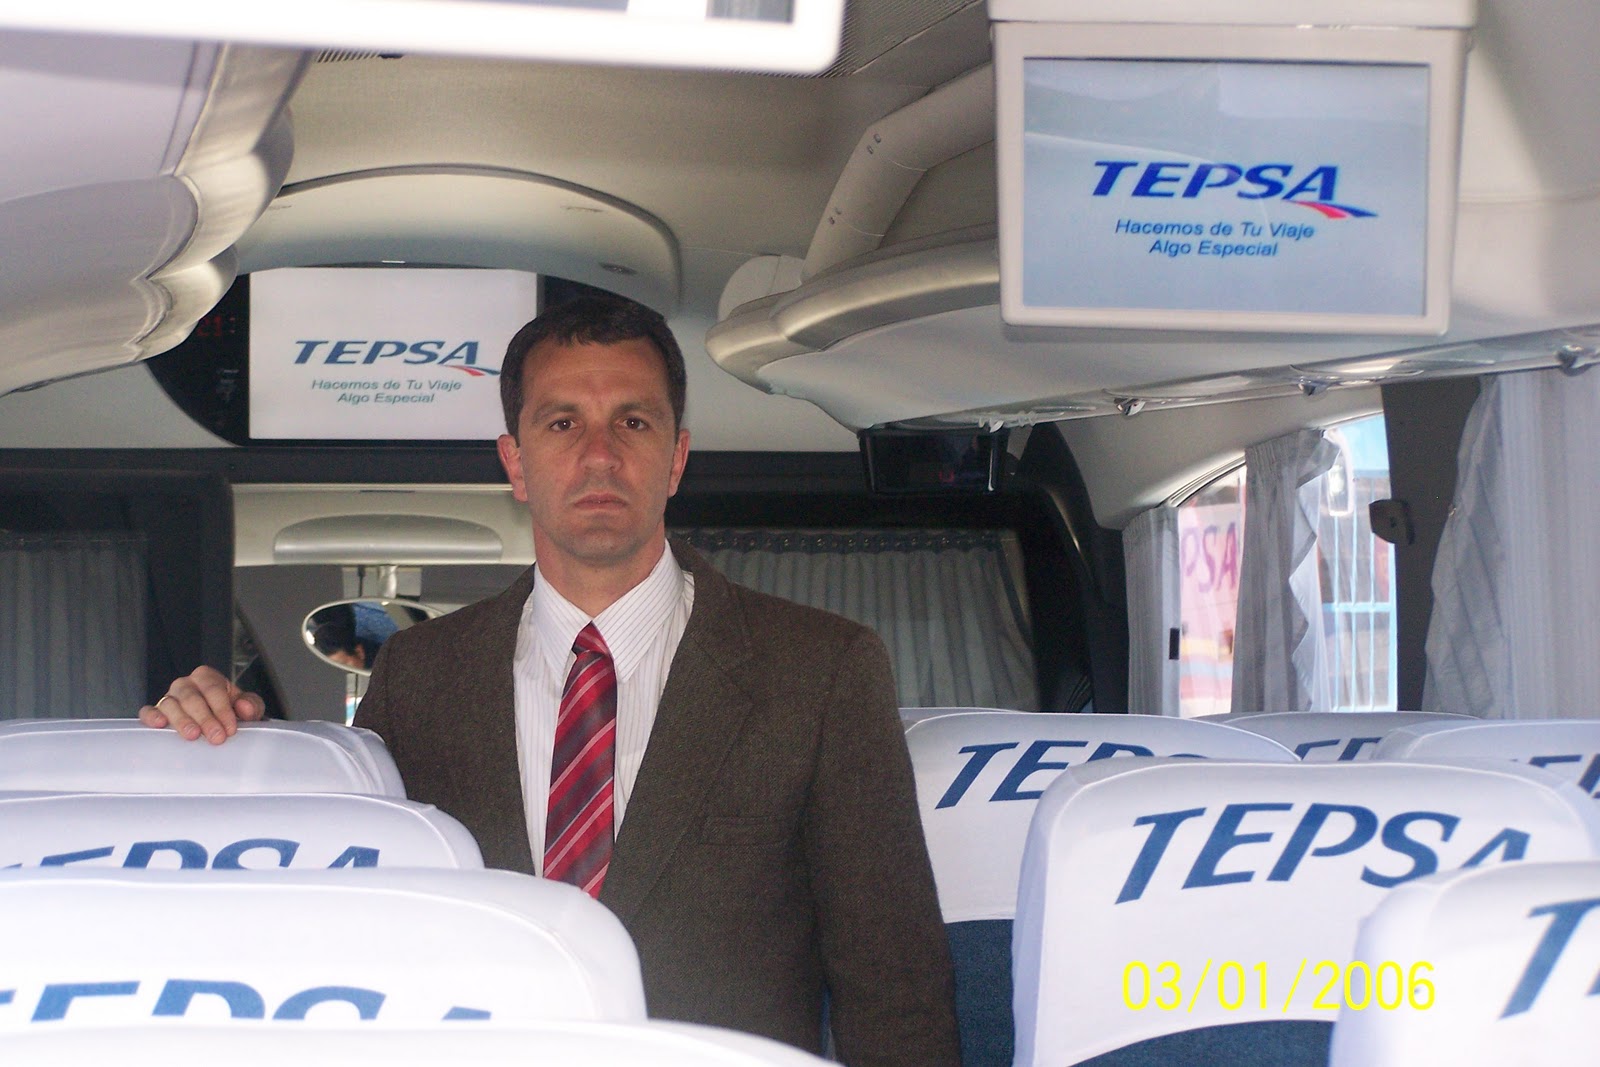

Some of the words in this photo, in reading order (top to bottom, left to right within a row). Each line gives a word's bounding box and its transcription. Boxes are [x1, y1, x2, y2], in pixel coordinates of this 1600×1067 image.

[1092, 160, 1338, 201] TEPSA
[1114, 218, 1203, 236] Hacemos
[1210, 220, 1232, 237] de
[1242, 221, 1262, 238] Tu
[1269, 222, 1315, 241] Viaje
[1149, 239, 1191, 258] Algo
[1198, 241, 1279, 259] Especial
[294, 340, 479, 365] TEPSA
[312, 379, 379, 390] Hacemos
[383, 379, 400, 390] de
[407, 379, 423, 390] Tu
[429, 379, 462, 393] Viaje
[337, 392, 369, 405] Algo
[374, 393, 435, 405] Especial
[935, 740, 1208, 809] TE
[1498, 898, 1600, 1020] T
